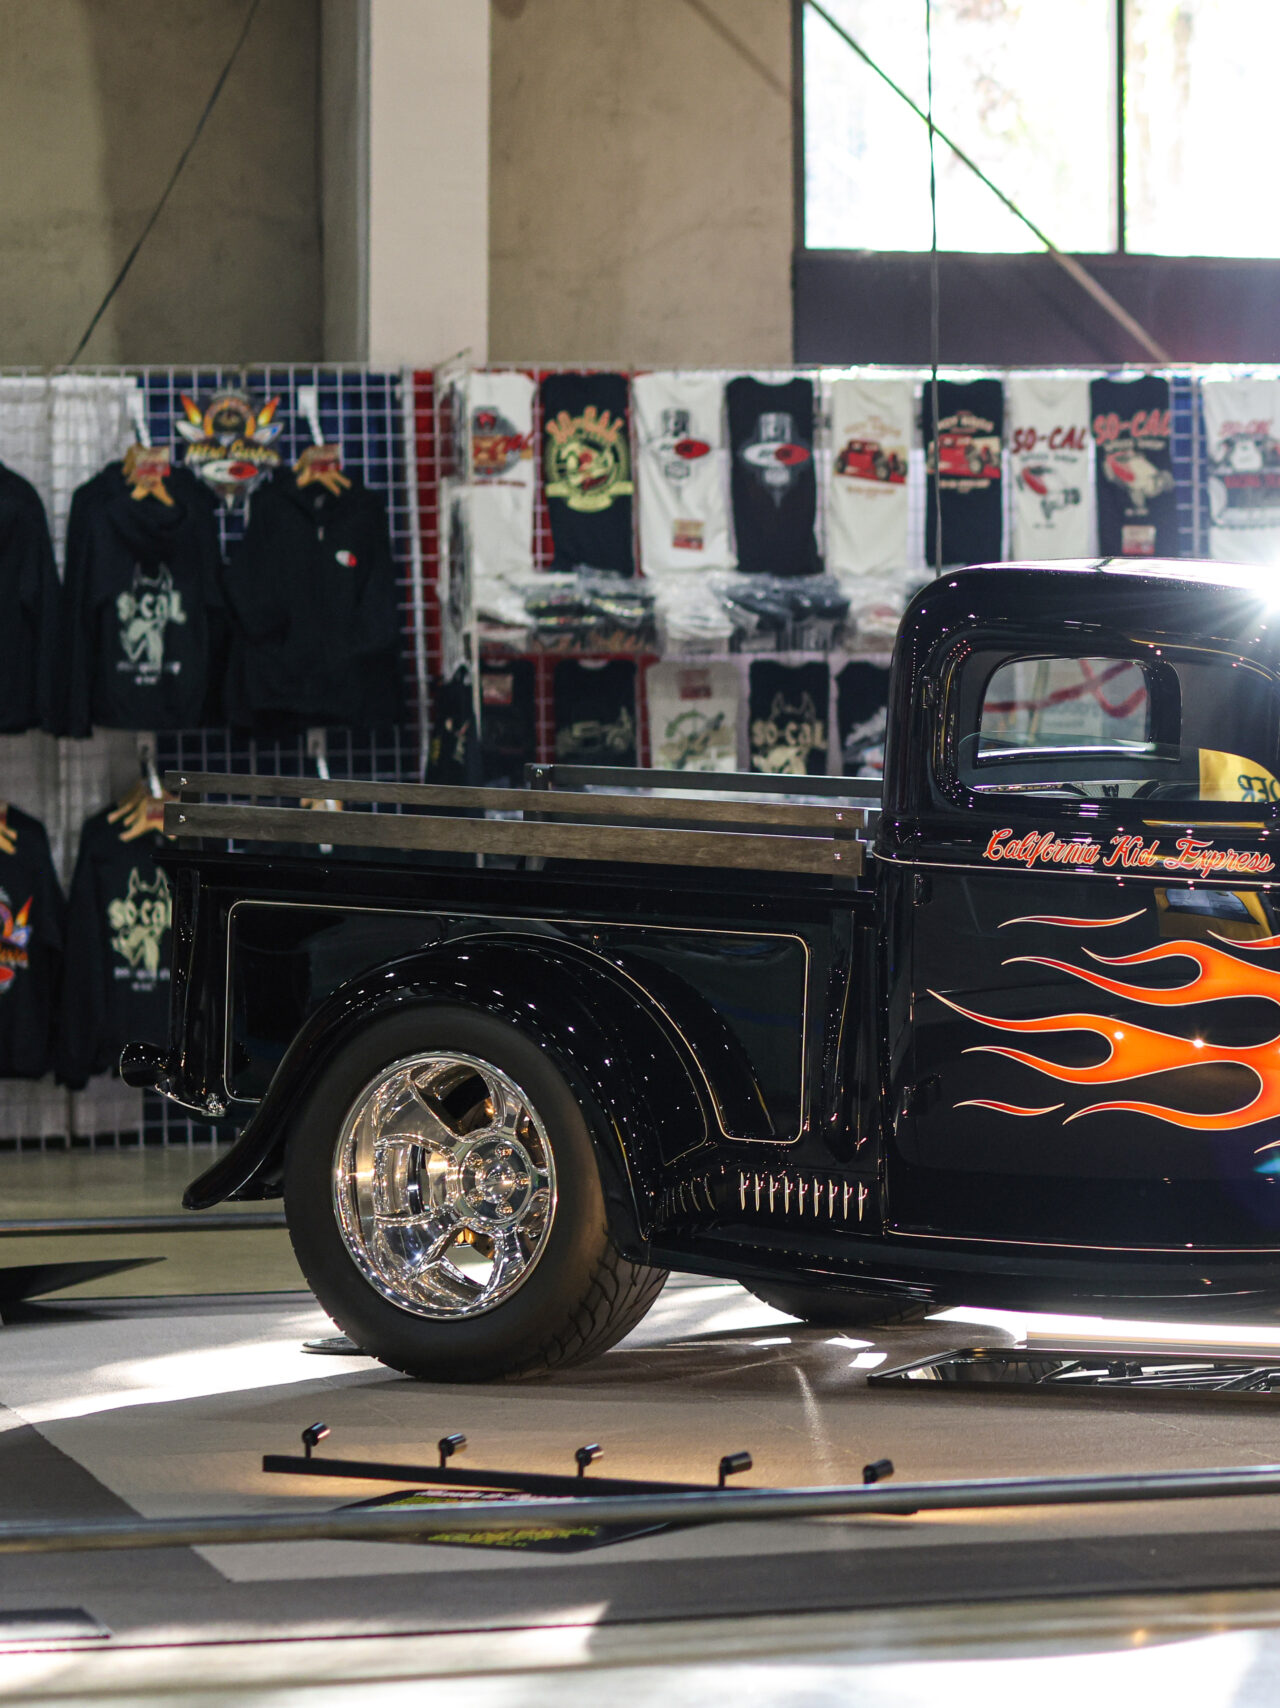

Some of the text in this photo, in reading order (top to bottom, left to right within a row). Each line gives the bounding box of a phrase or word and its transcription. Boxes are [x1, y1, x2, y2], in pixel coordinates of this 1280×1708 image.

[1012, 427, 1086, 454] SO-CAL
[1092, 409, 1170, 445] SO-CAL
[752, 719, 827, 749] SO-CAL
[982, 828, 1276, 879] California Kid Express
